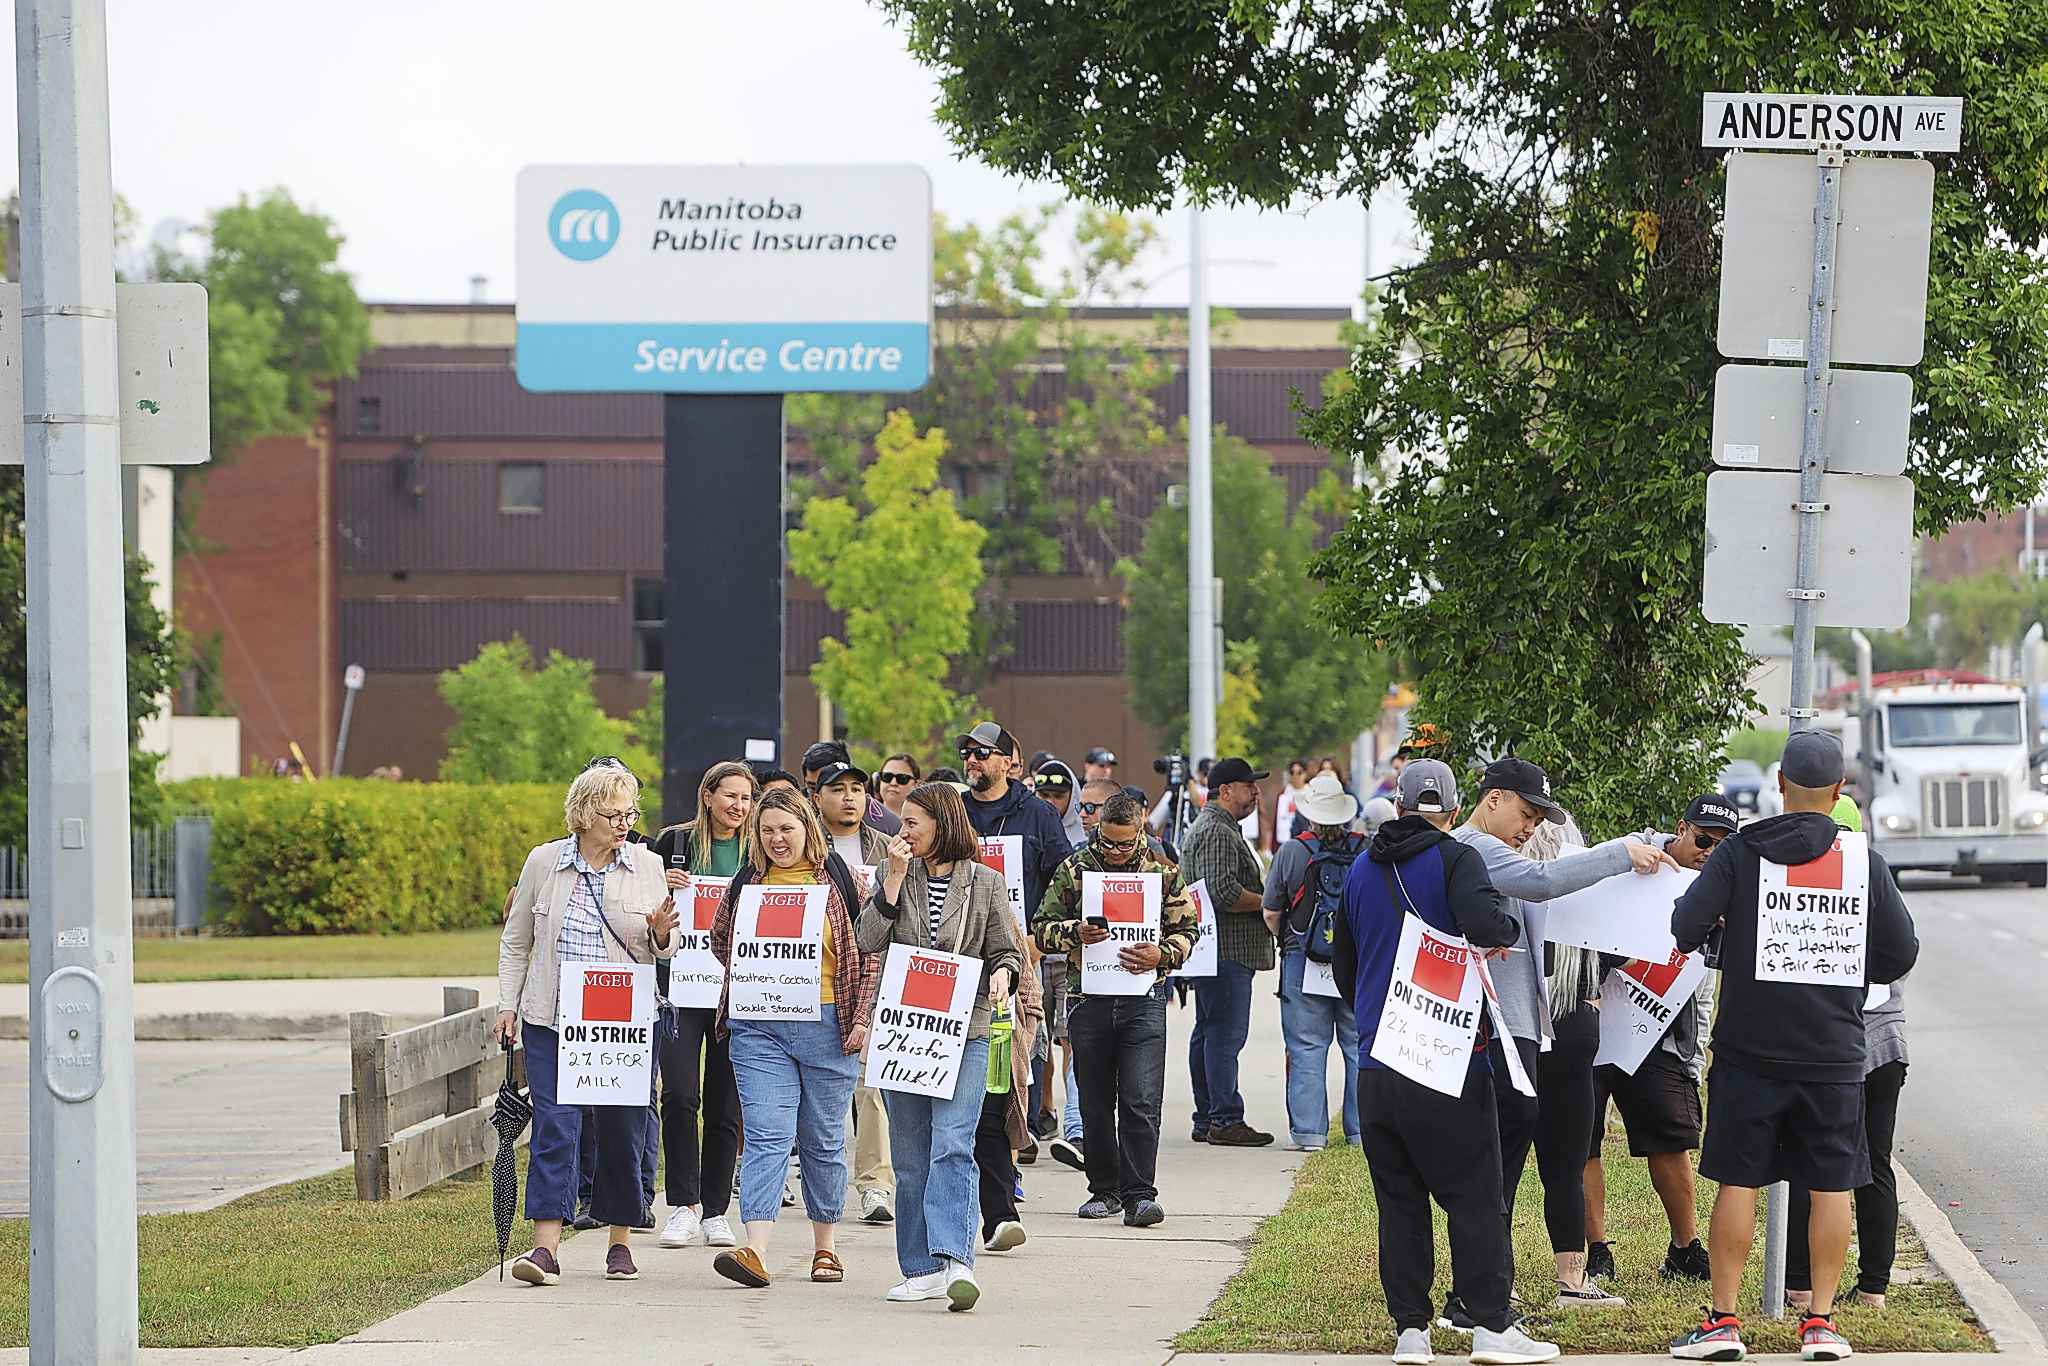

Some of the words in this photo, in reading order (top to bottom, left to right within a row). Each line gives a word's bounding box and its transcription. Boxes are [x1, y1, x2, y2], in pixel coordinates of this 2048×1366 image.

[1718, 102, 1902, 142] ANDERSON
[1915, 112, 1946, 131] AVE
[658, 197, 802, 221] Manitoba
[651, 228, 742, 252] Public
[751, 229, 897, 252] Insurance
[633, 338, 767, 373] Service
[778, 340, 901, 373] Centre
[979, 845, 1004, 857] GEU
[1102, 882, 1144, 894] MGEU
[760, 894, 808, 906] MGEU
[1766, 891, 1791, 910] ON
[1796, 893, 1860, 915] STRIKE
[1111, 927, 1156, 942] STRIKE
[1770, 916, 1817, 936] What's
[1822, 917, 1855, 938] fair
[738, 942, 759, 958] ON
[763, 943, 816, 960] STRIKE
[1419, 936, 1469, 966] MGEU
[1763, 938, 1789, 956] for
[1798, 939, 1861, 955] Heather
[907, 958, 960, 979] MGEU
[1761, 955, 1776, 973] is
[1782, 956, 1808, 973] fair
[1813, 958, 1838, 974] for
[1844, 957, 1862, 977] us!
[584, 973, 634, 988] MGEU
[672, 970, 723, 985] Fairness
[761, 993, 782, 1002] The
[1394, 980, 1413, 1005] ON
[1414, 994, 1474, 1029] STRIKE
[880, 1007, 904, 1027] ON
[905, 1012, 964, 1038] STRIKE
[565, 1026, 587, 1043] ON
[590, 1026, 647, 1044] STRIKE
[600, 1052, 613, 1066] IS
[616, 1052, 644, 1068] FOR
[909, 1041, 924, 1056] is
[924, 1038, 950, 1061] for
[1398, 1043, 1435, 1072] MILK
[576, 1075, 622, 1089] MILK
